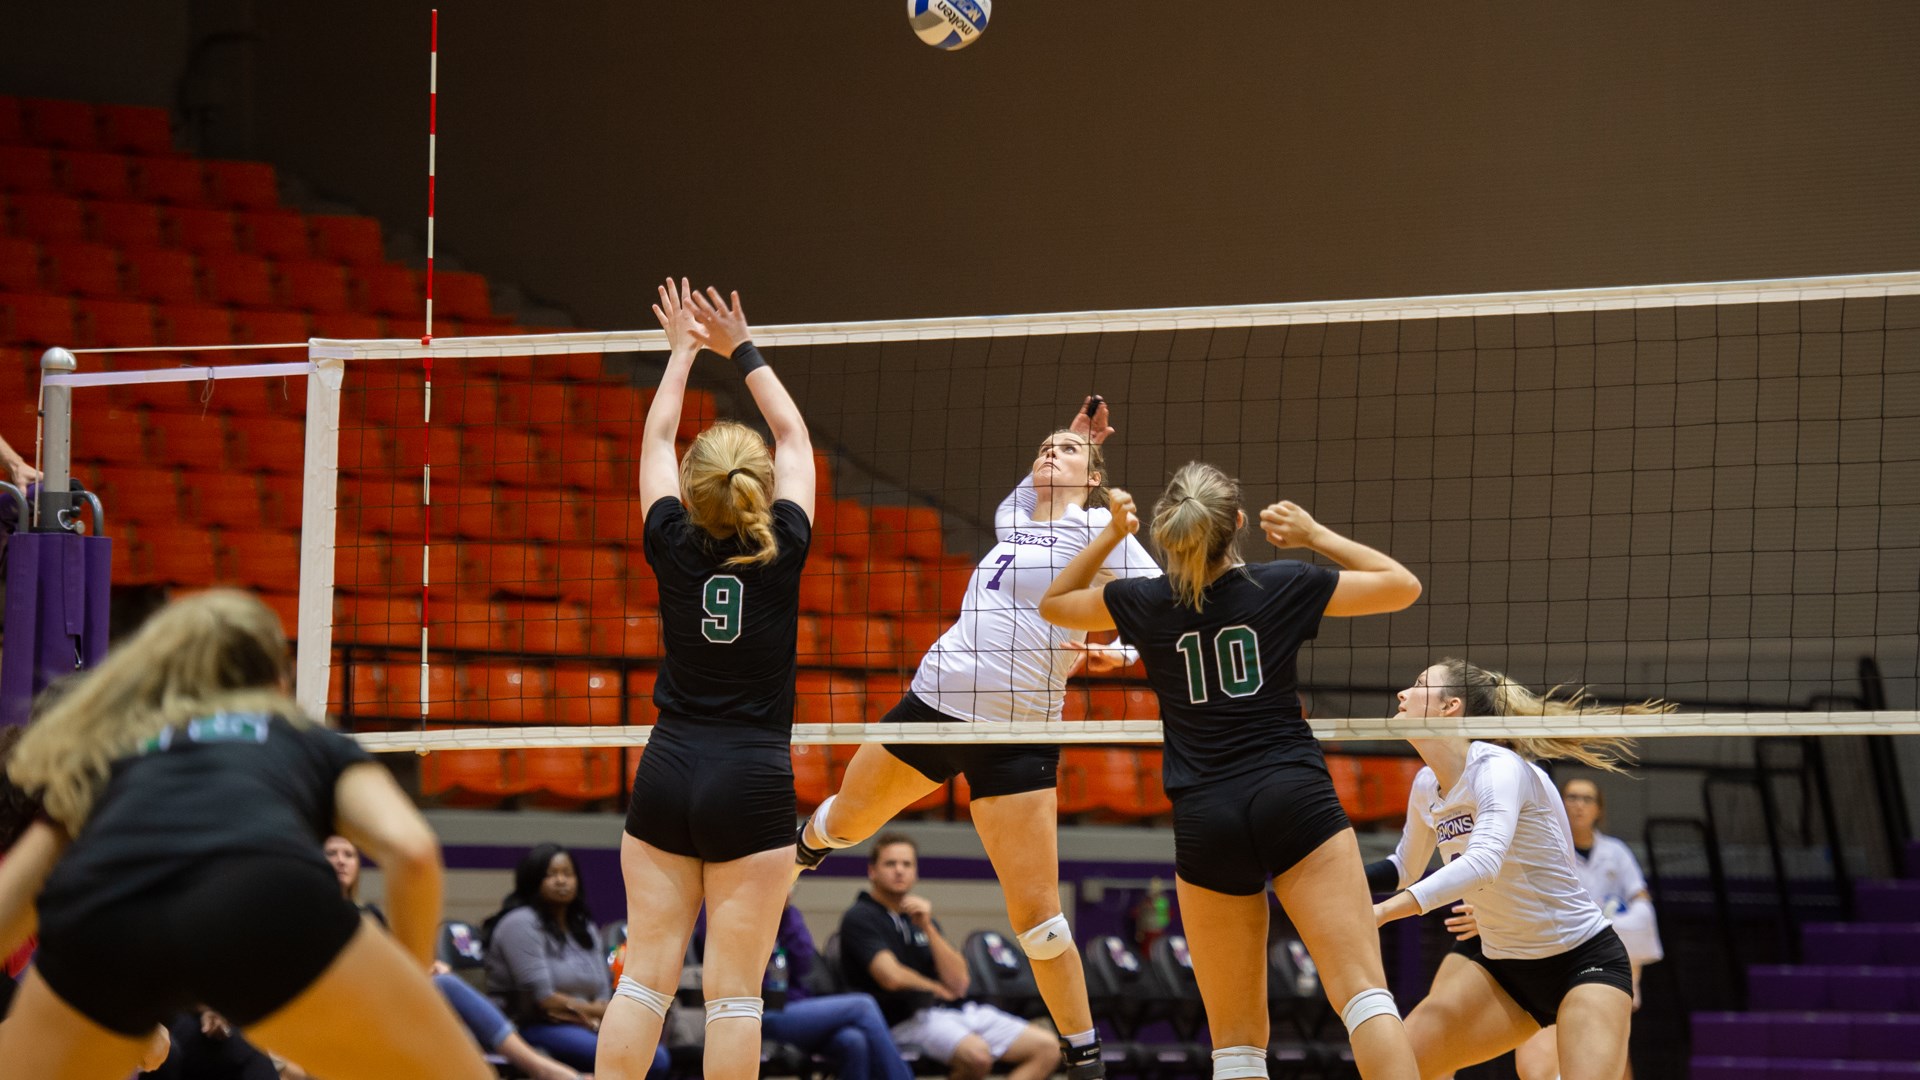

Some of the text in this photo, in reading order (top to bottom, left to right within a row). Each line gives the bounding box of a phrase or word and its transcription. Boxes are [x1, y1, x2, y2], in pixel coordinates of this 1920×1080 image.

[937, 1, 974, 36] molten
[986, 554, 1016, 591] 7
[702, 575, 743, 643] 9
[1176, 625, 1263, 704] 10
